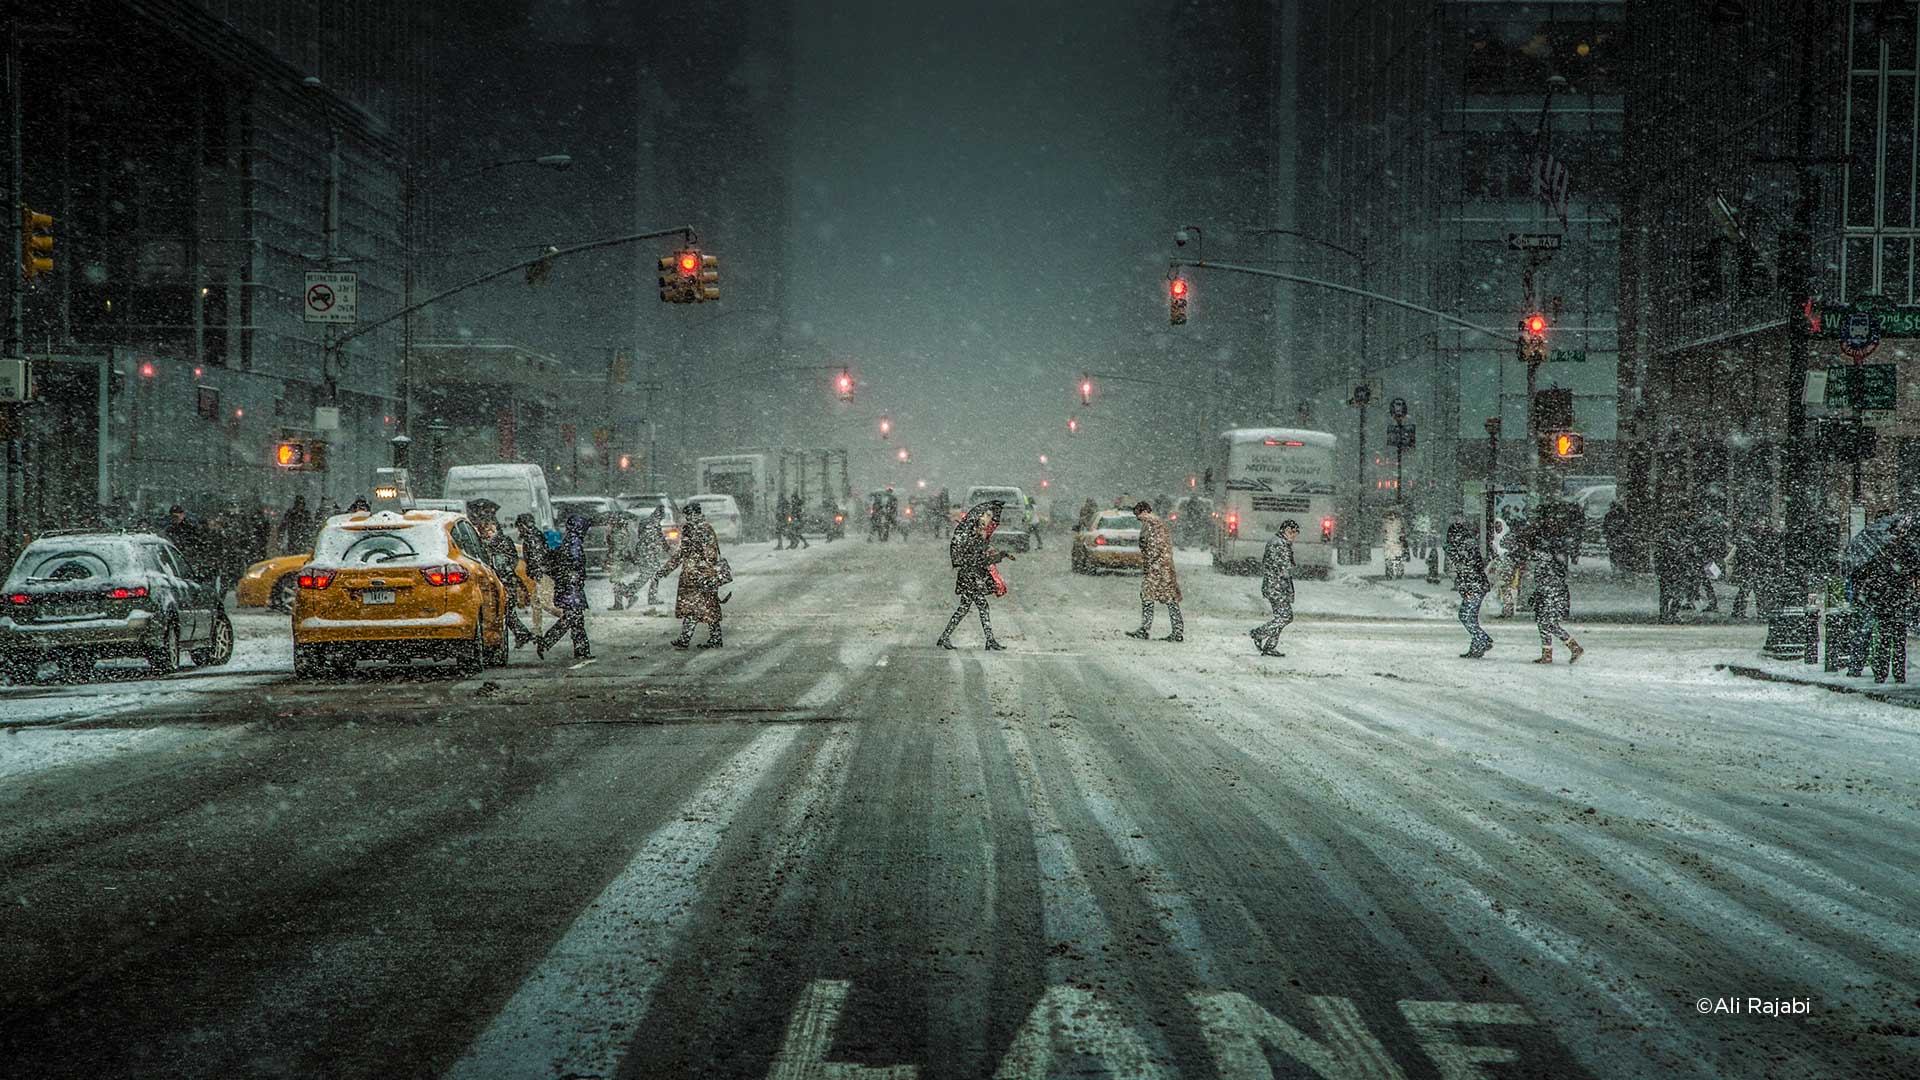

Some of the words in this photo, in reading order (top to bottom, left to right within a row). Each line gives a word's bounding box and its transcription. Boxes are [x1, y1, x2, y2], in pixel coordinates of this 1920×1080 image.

[1824, 313, 1841, 328] W
[1879, 312, 1900, 329] 2nd
[1904, 314, 1920, 330] St
[1245, 464, 1281, 472] MOTOR
